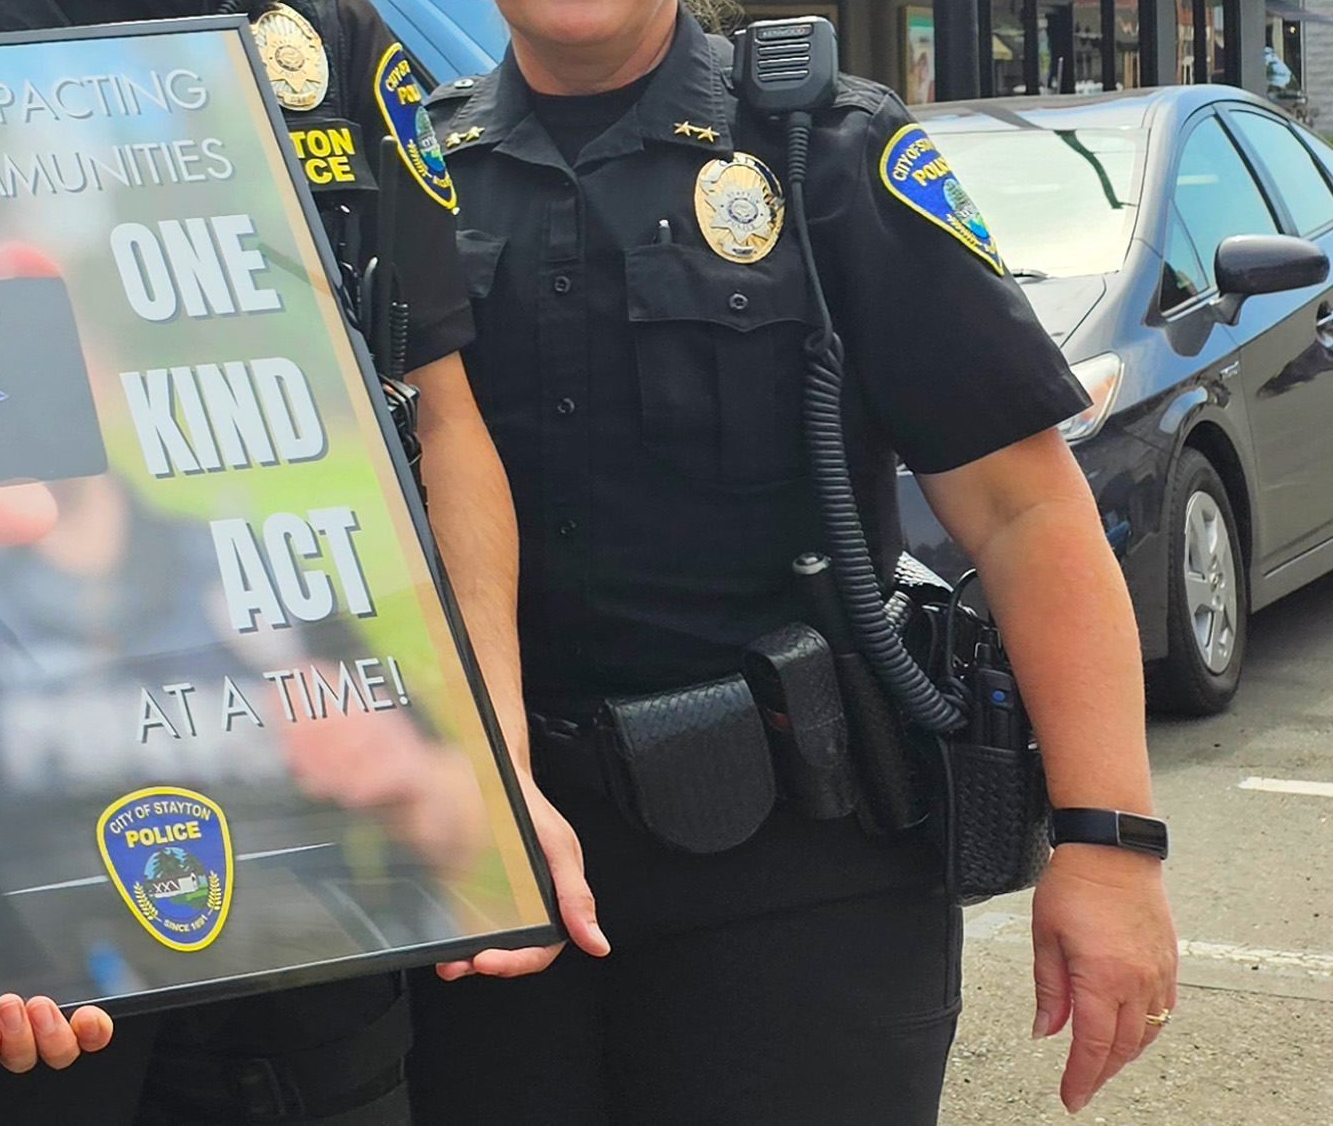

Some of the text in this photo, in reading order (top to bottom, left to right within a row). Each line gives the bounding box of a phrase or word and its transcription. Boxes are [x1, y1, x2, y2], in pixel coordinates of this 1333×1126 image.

[110, 214, 283, 322] ONE
[119, 357, 327, 478] KIND
[210, 506, 376, 632] ACT
[136, 683, 198, 744] AT
[221, 676, 264, 732] A
[262, 656, 411, 723] TIME!
[109, 800, 212, 835] CITY OF STAYTON
[125, 820, 203, 849] POLICE
